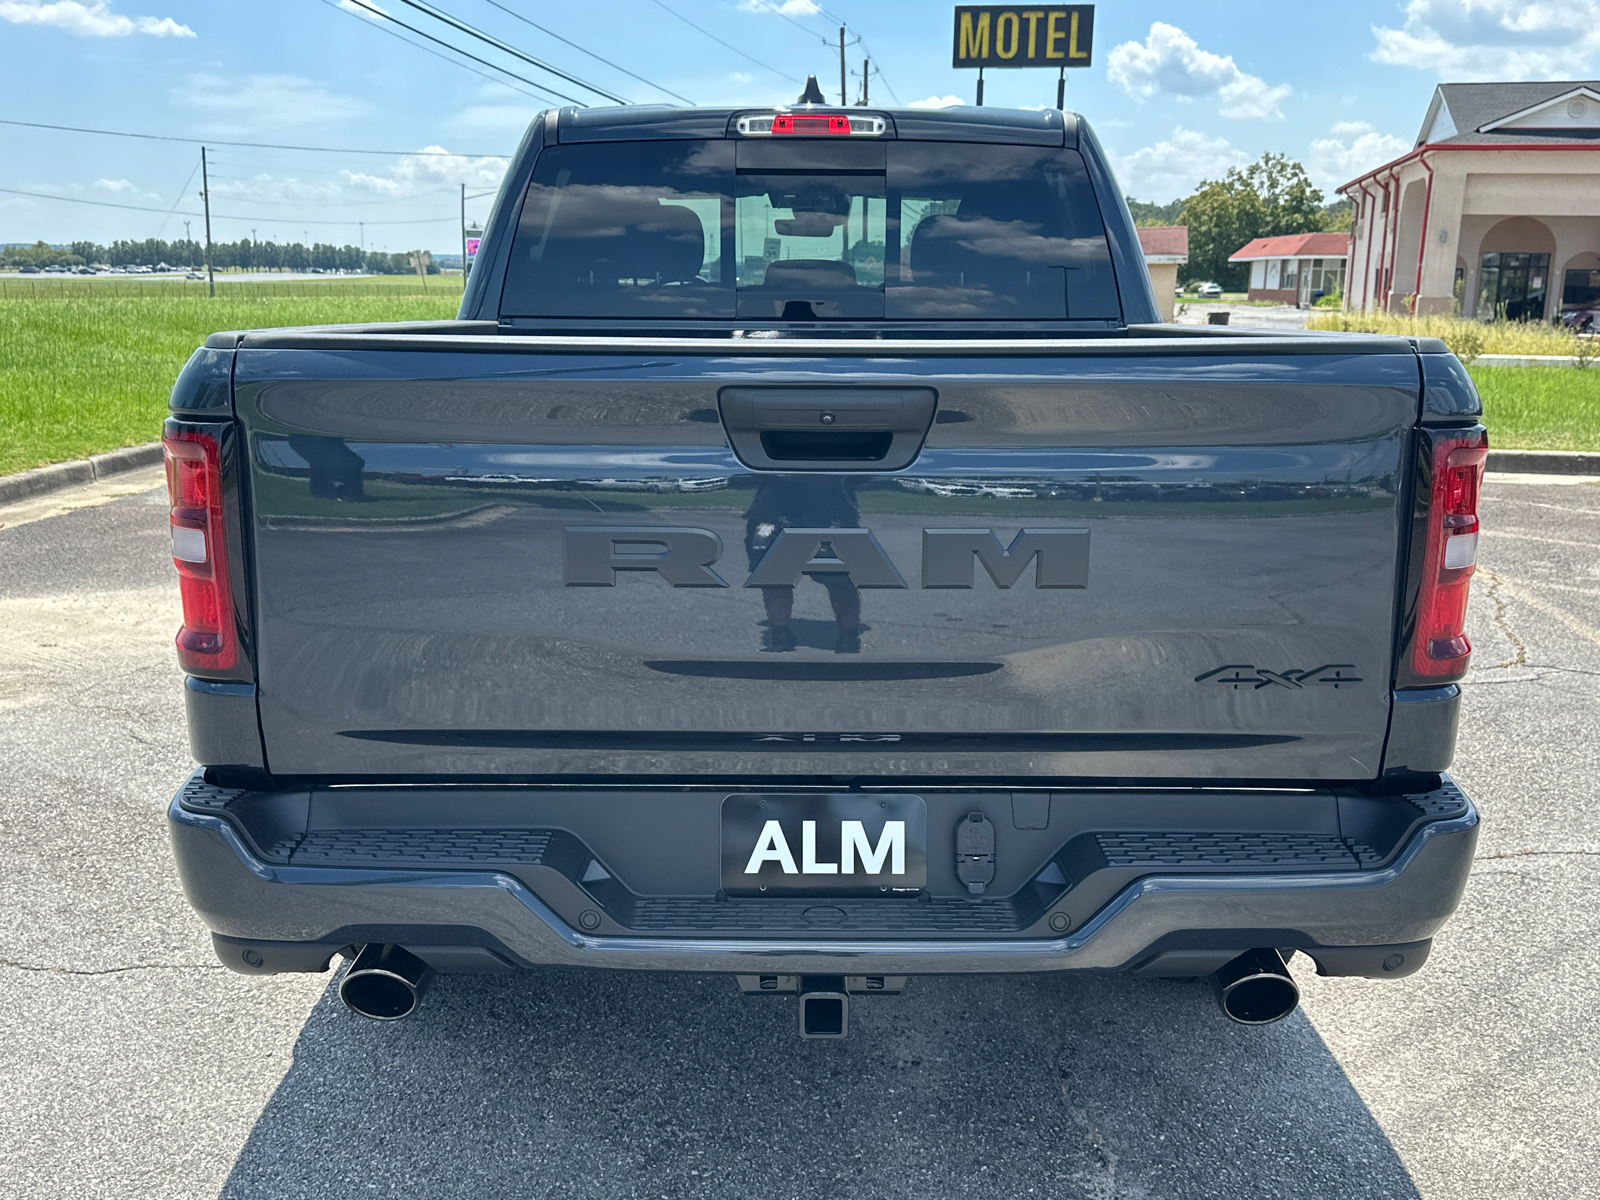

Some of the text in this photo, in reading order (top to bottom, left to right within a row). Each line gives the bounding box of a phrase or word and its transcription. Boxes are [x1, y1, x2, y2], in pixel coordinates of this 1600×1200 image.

[959, 11, 1088, 59] MOTEL
[563, 525, 1091, 589] RAM
[744, 820, 906, 875] ALM
